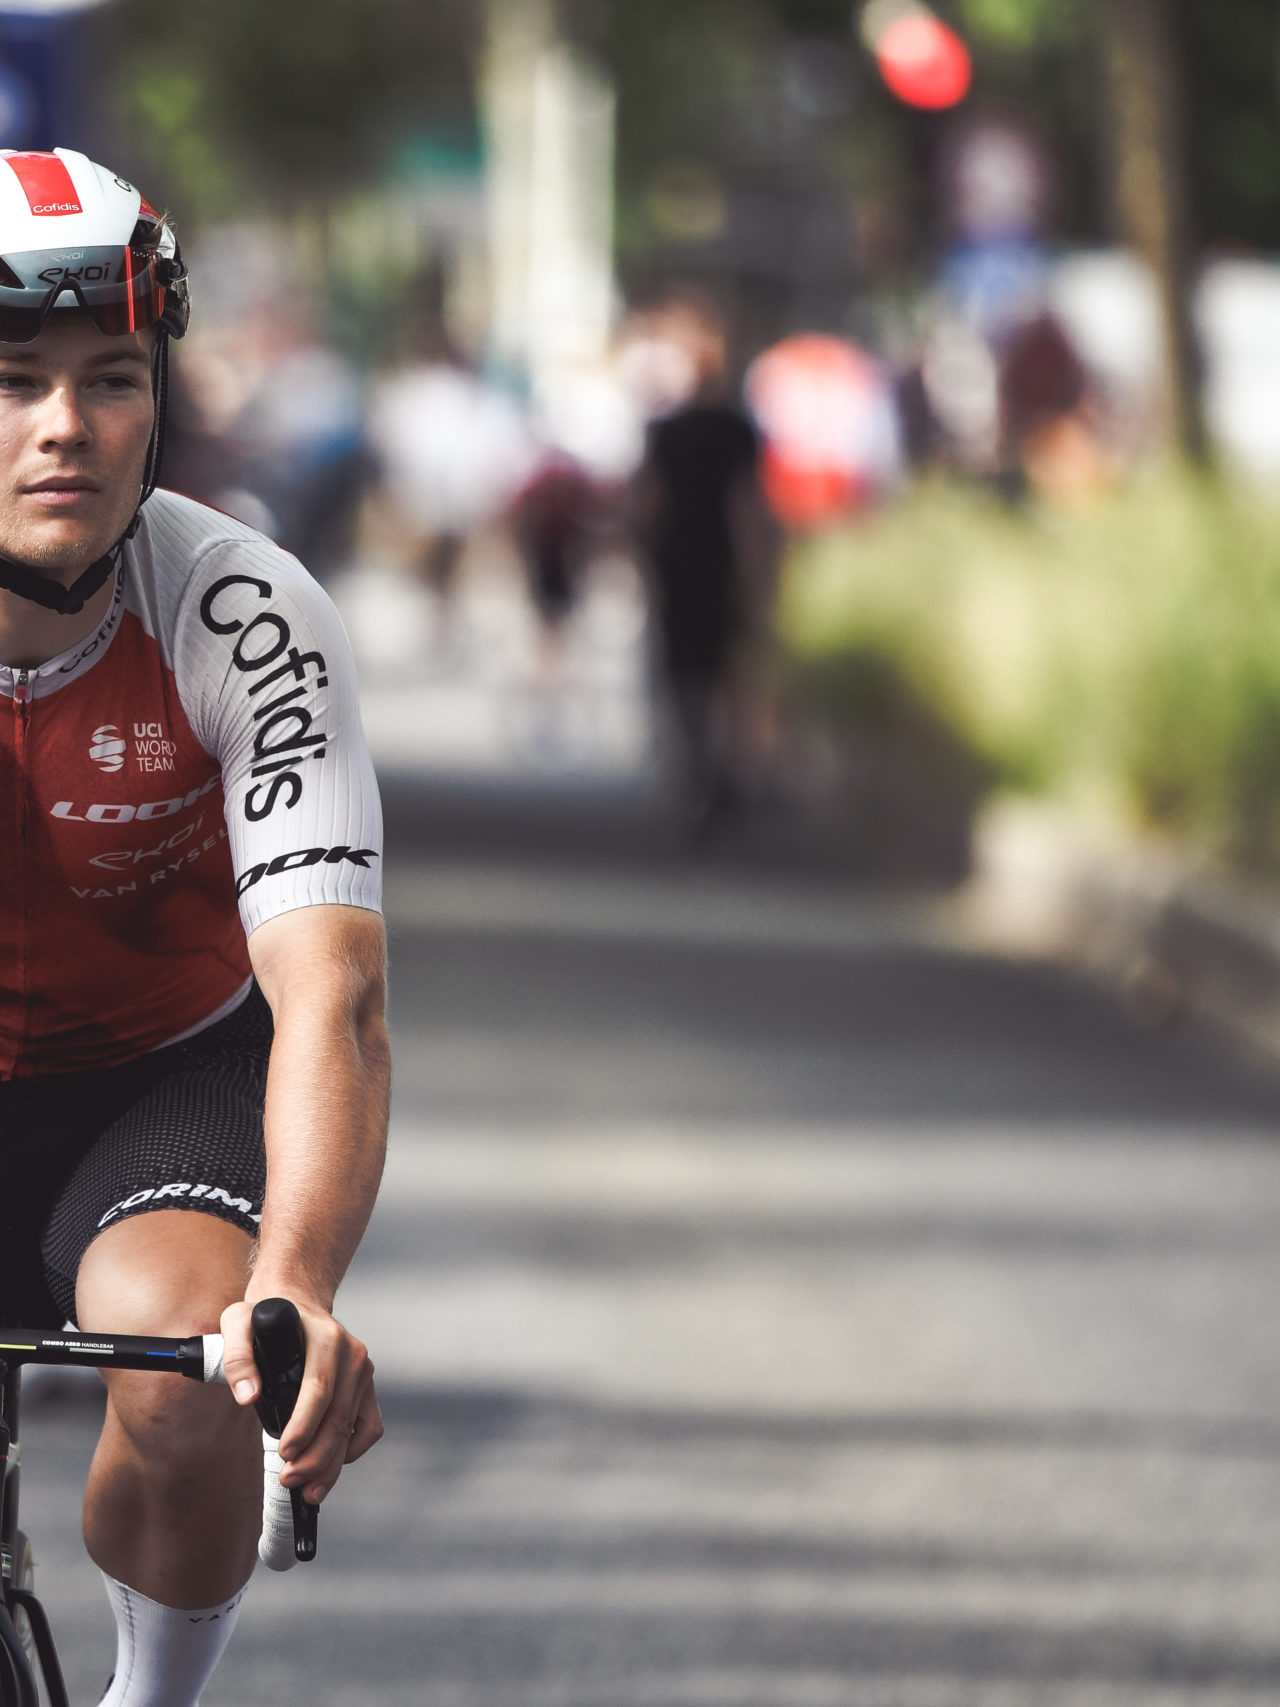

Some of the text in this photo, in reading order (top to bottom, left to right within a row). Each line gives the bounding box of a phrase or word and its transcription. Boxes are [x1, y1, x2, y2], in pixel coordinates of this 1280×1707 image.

[32, 203, 80, 213] Cofidis
[200, 574, 329, 822] Cofidis
[133, 723, 163, 738] UCI
[50, 773, 222, 823] LOOK
[236, 846, 379, 900] OOK
[70, 882, 137, 899] VAN
